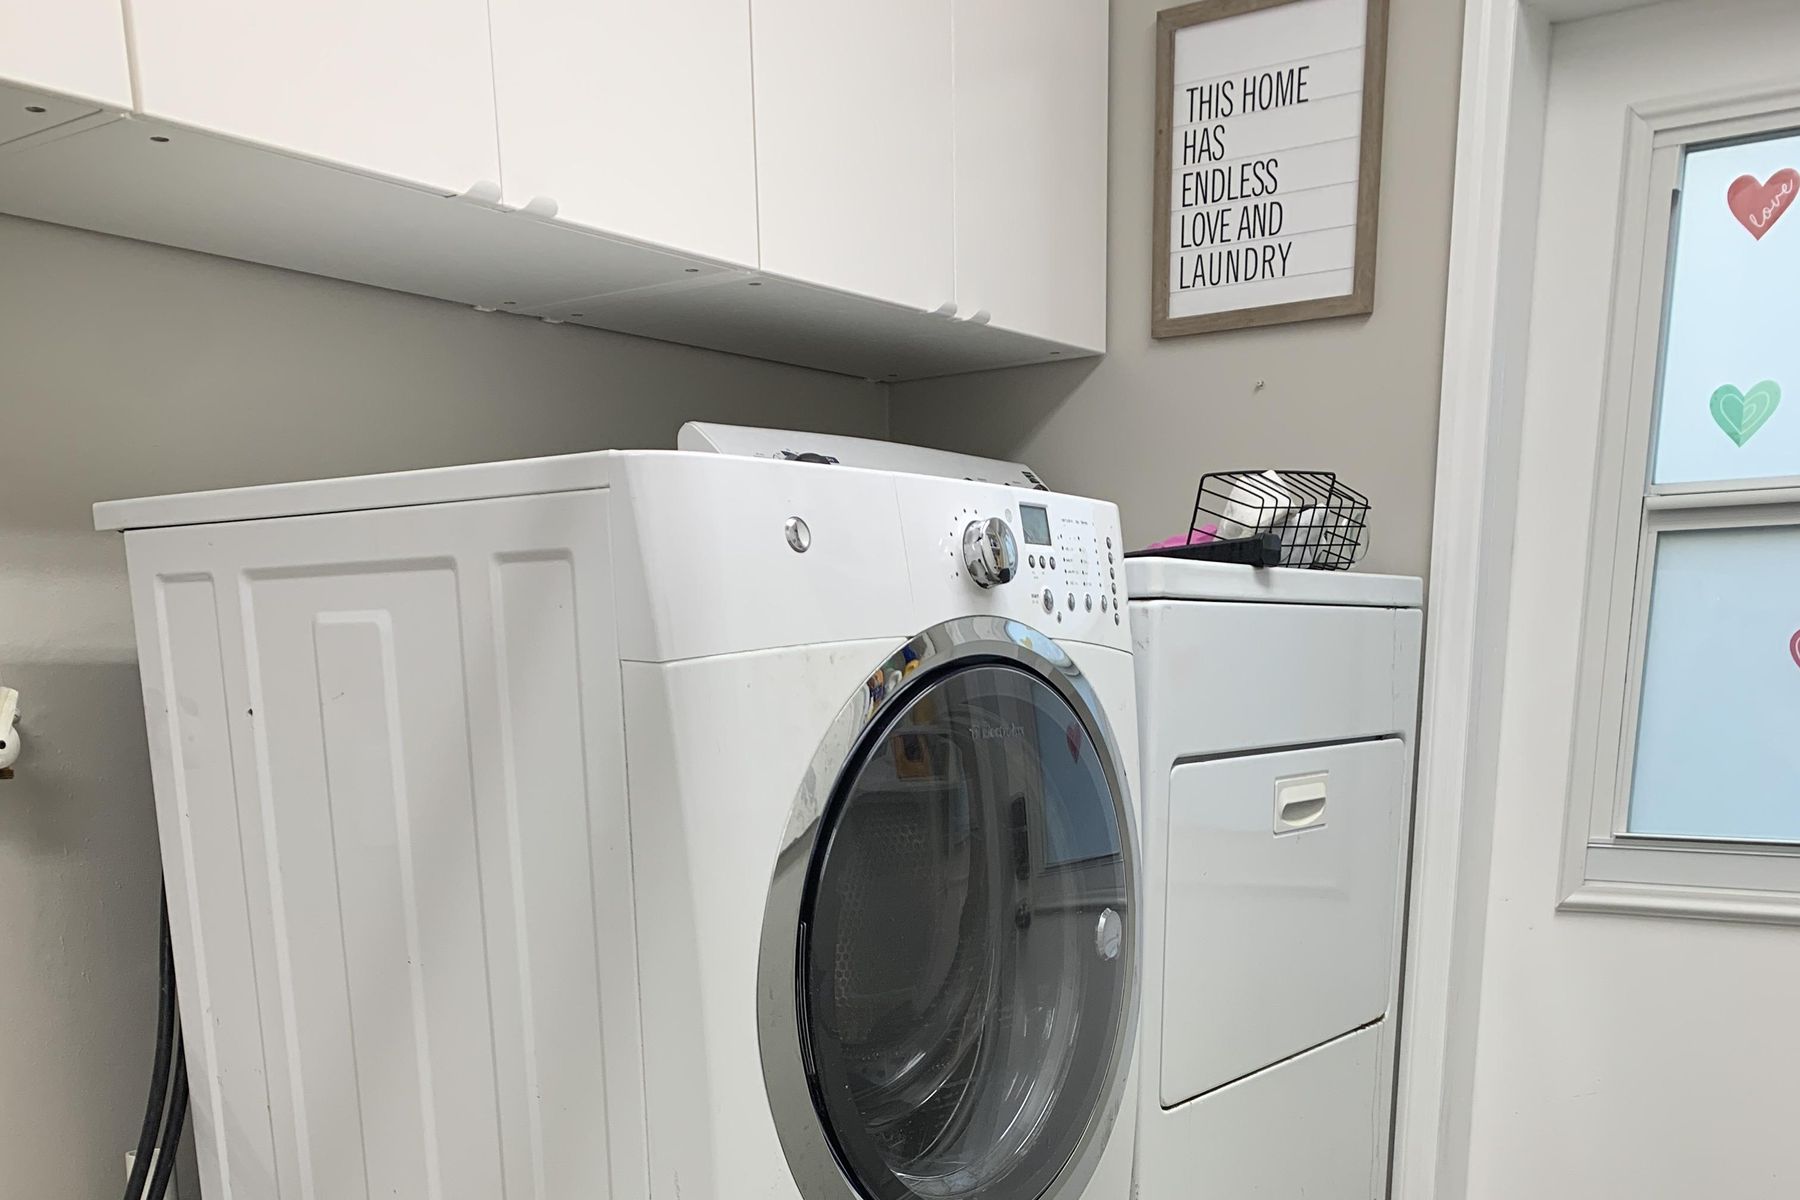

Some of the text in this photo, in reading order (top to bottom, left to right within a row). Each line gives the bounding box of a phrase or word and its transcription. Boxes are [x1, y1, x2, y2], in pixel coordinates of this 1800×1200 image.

[1186, 65, 1310, 123] THIS HOME
[1183, 124, 1225, 166] HAS
[1182, 158, 1278, 208] ENDLESS
[1749, 178, 1793, 228] love
[1181, 201, 1283, 249] LOVE AND
[1179, 242, 1292, 289] LAUNDRY
